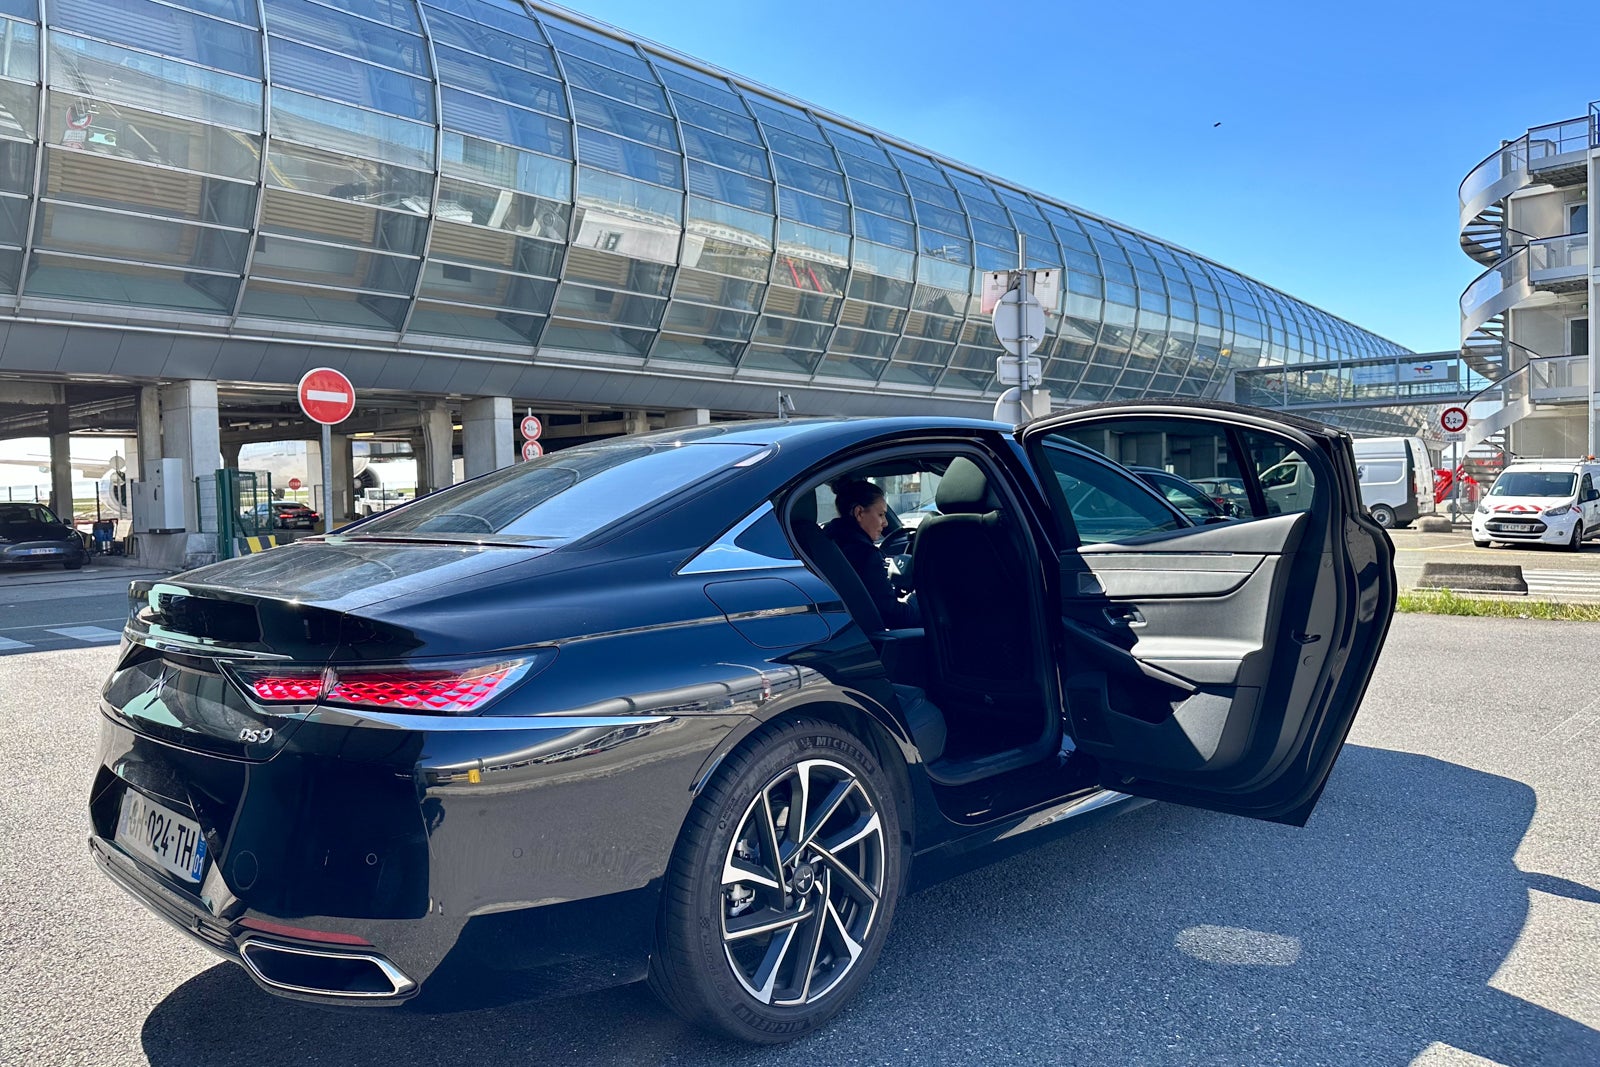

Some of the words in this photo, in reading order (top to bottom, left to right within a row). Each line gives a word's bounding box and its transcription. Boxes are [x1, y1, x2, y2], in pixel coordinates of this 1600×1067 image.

[815, 735, 875, 775] MICHELIN
[193, 854, 204, 875] 01
[735, 1004, 806, 1033] MICHELIN
